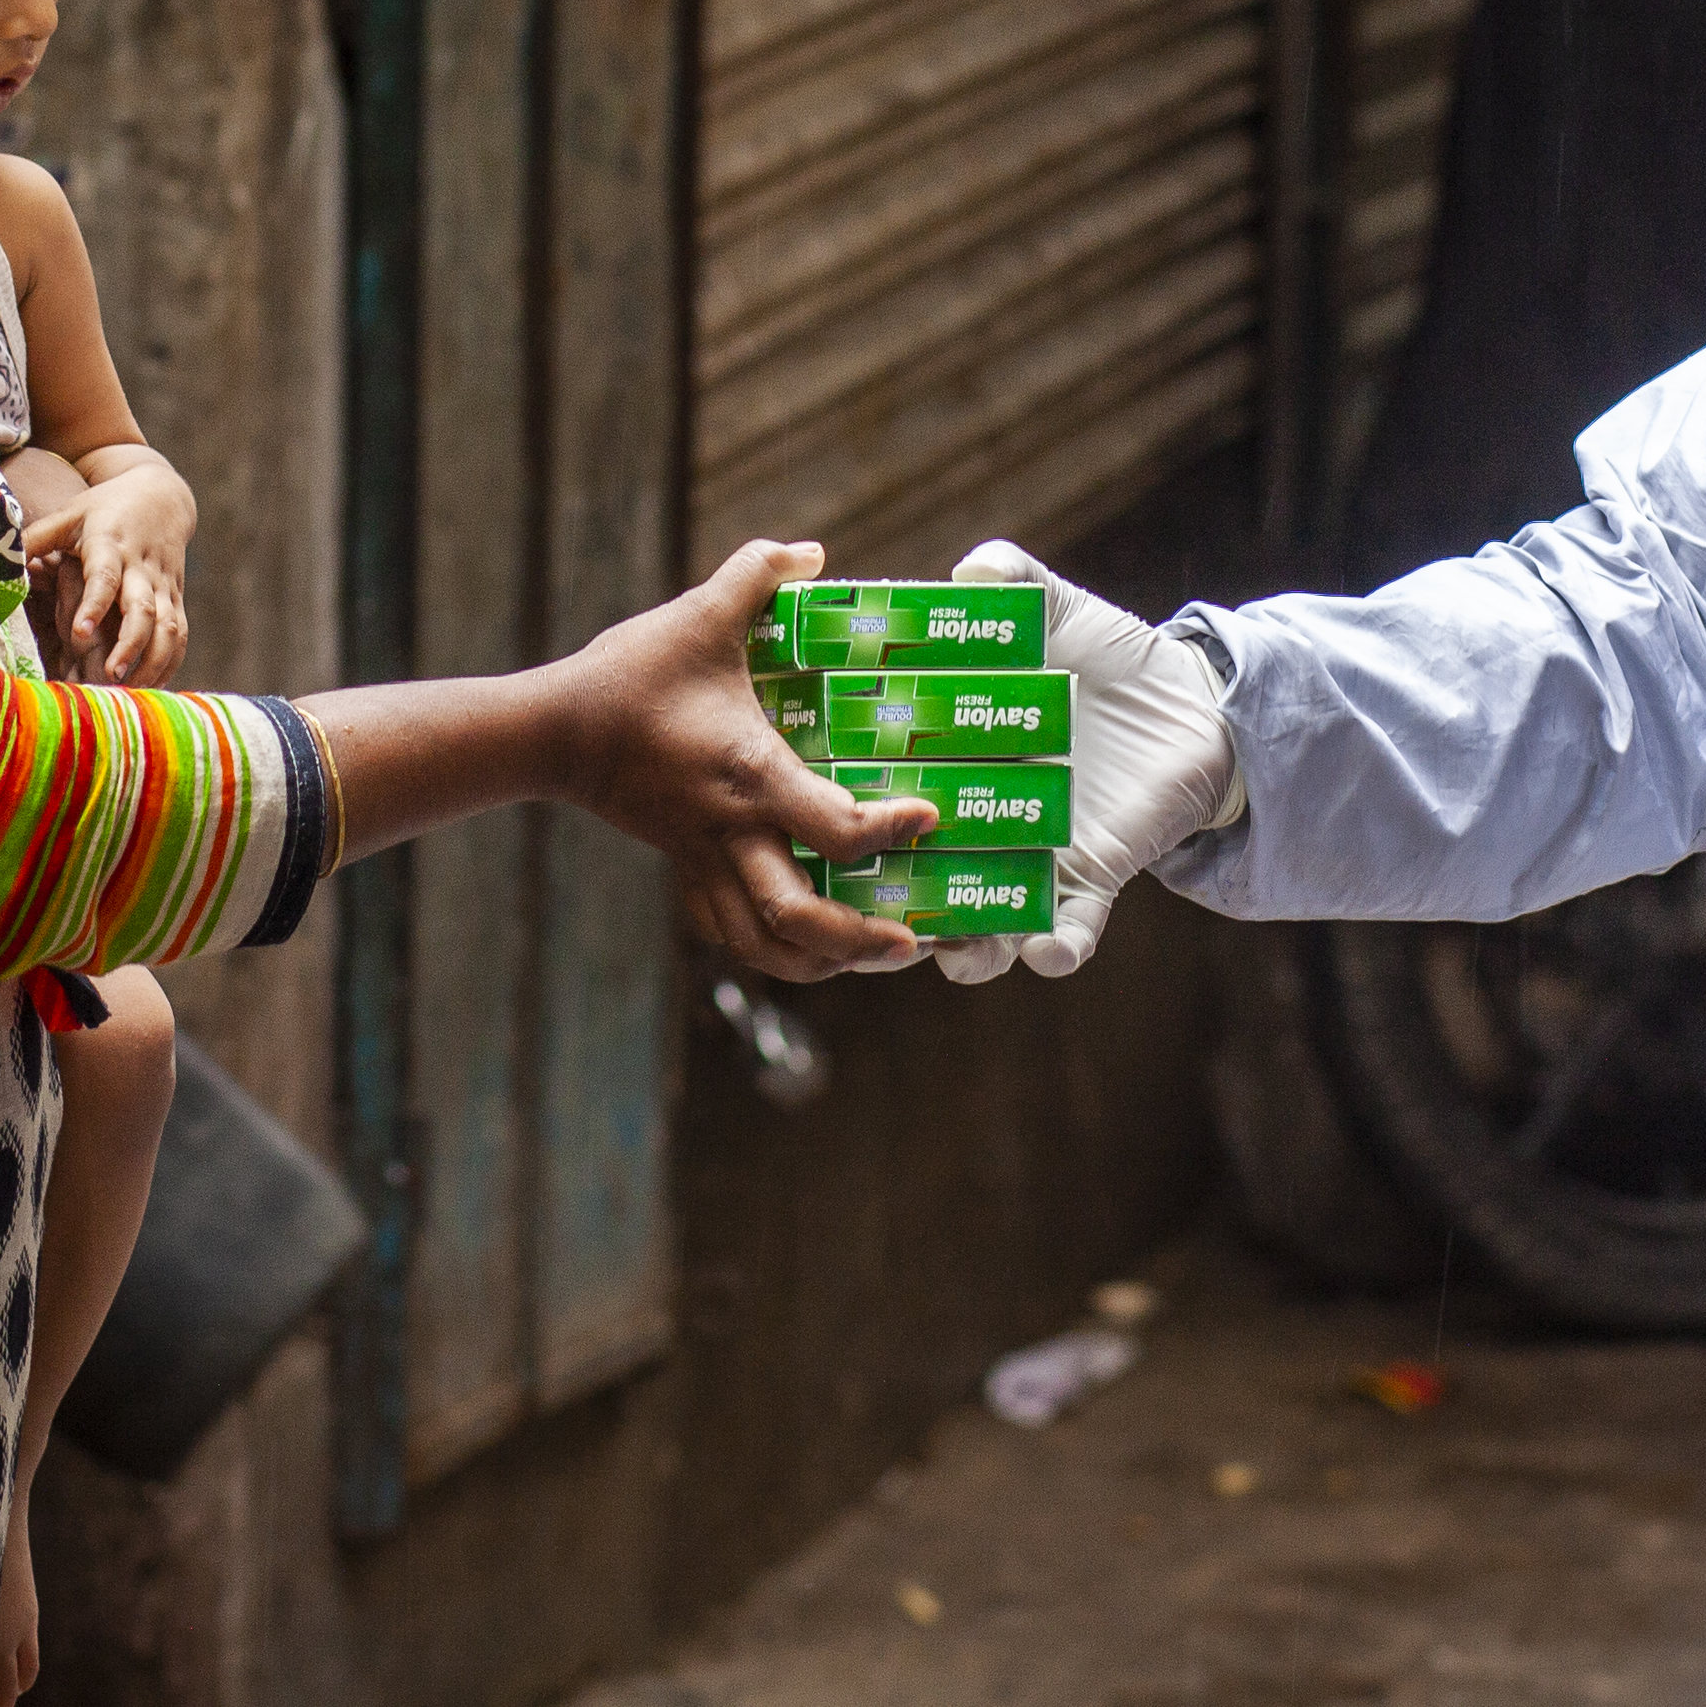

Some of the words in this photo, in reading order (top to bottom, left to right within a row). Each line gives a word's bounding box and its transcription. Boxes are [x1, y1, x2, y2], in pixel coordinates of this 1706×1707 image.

[929, 607, 967, 618] FRESH
[755, 623, 785, 642] Savlon
[850, 624, 886, 633] DOUBLE
[928, 621, 1015, 644] Savlon
[955, 695, 992, 706] FRESH
[783, 709, 816, 729] Savlon
[876, 712, 912, 721] DOUBLE
[954, 706, 1041, 731] Savlon
[958, 787, 995, 798] FRESH
[957, 799, 1042, 822] Savlon
[948, 874, 983, 885] FRESH
[874, 892, 909, 901] DOUBLE
[948, 886, 1027, 910] Savlon
